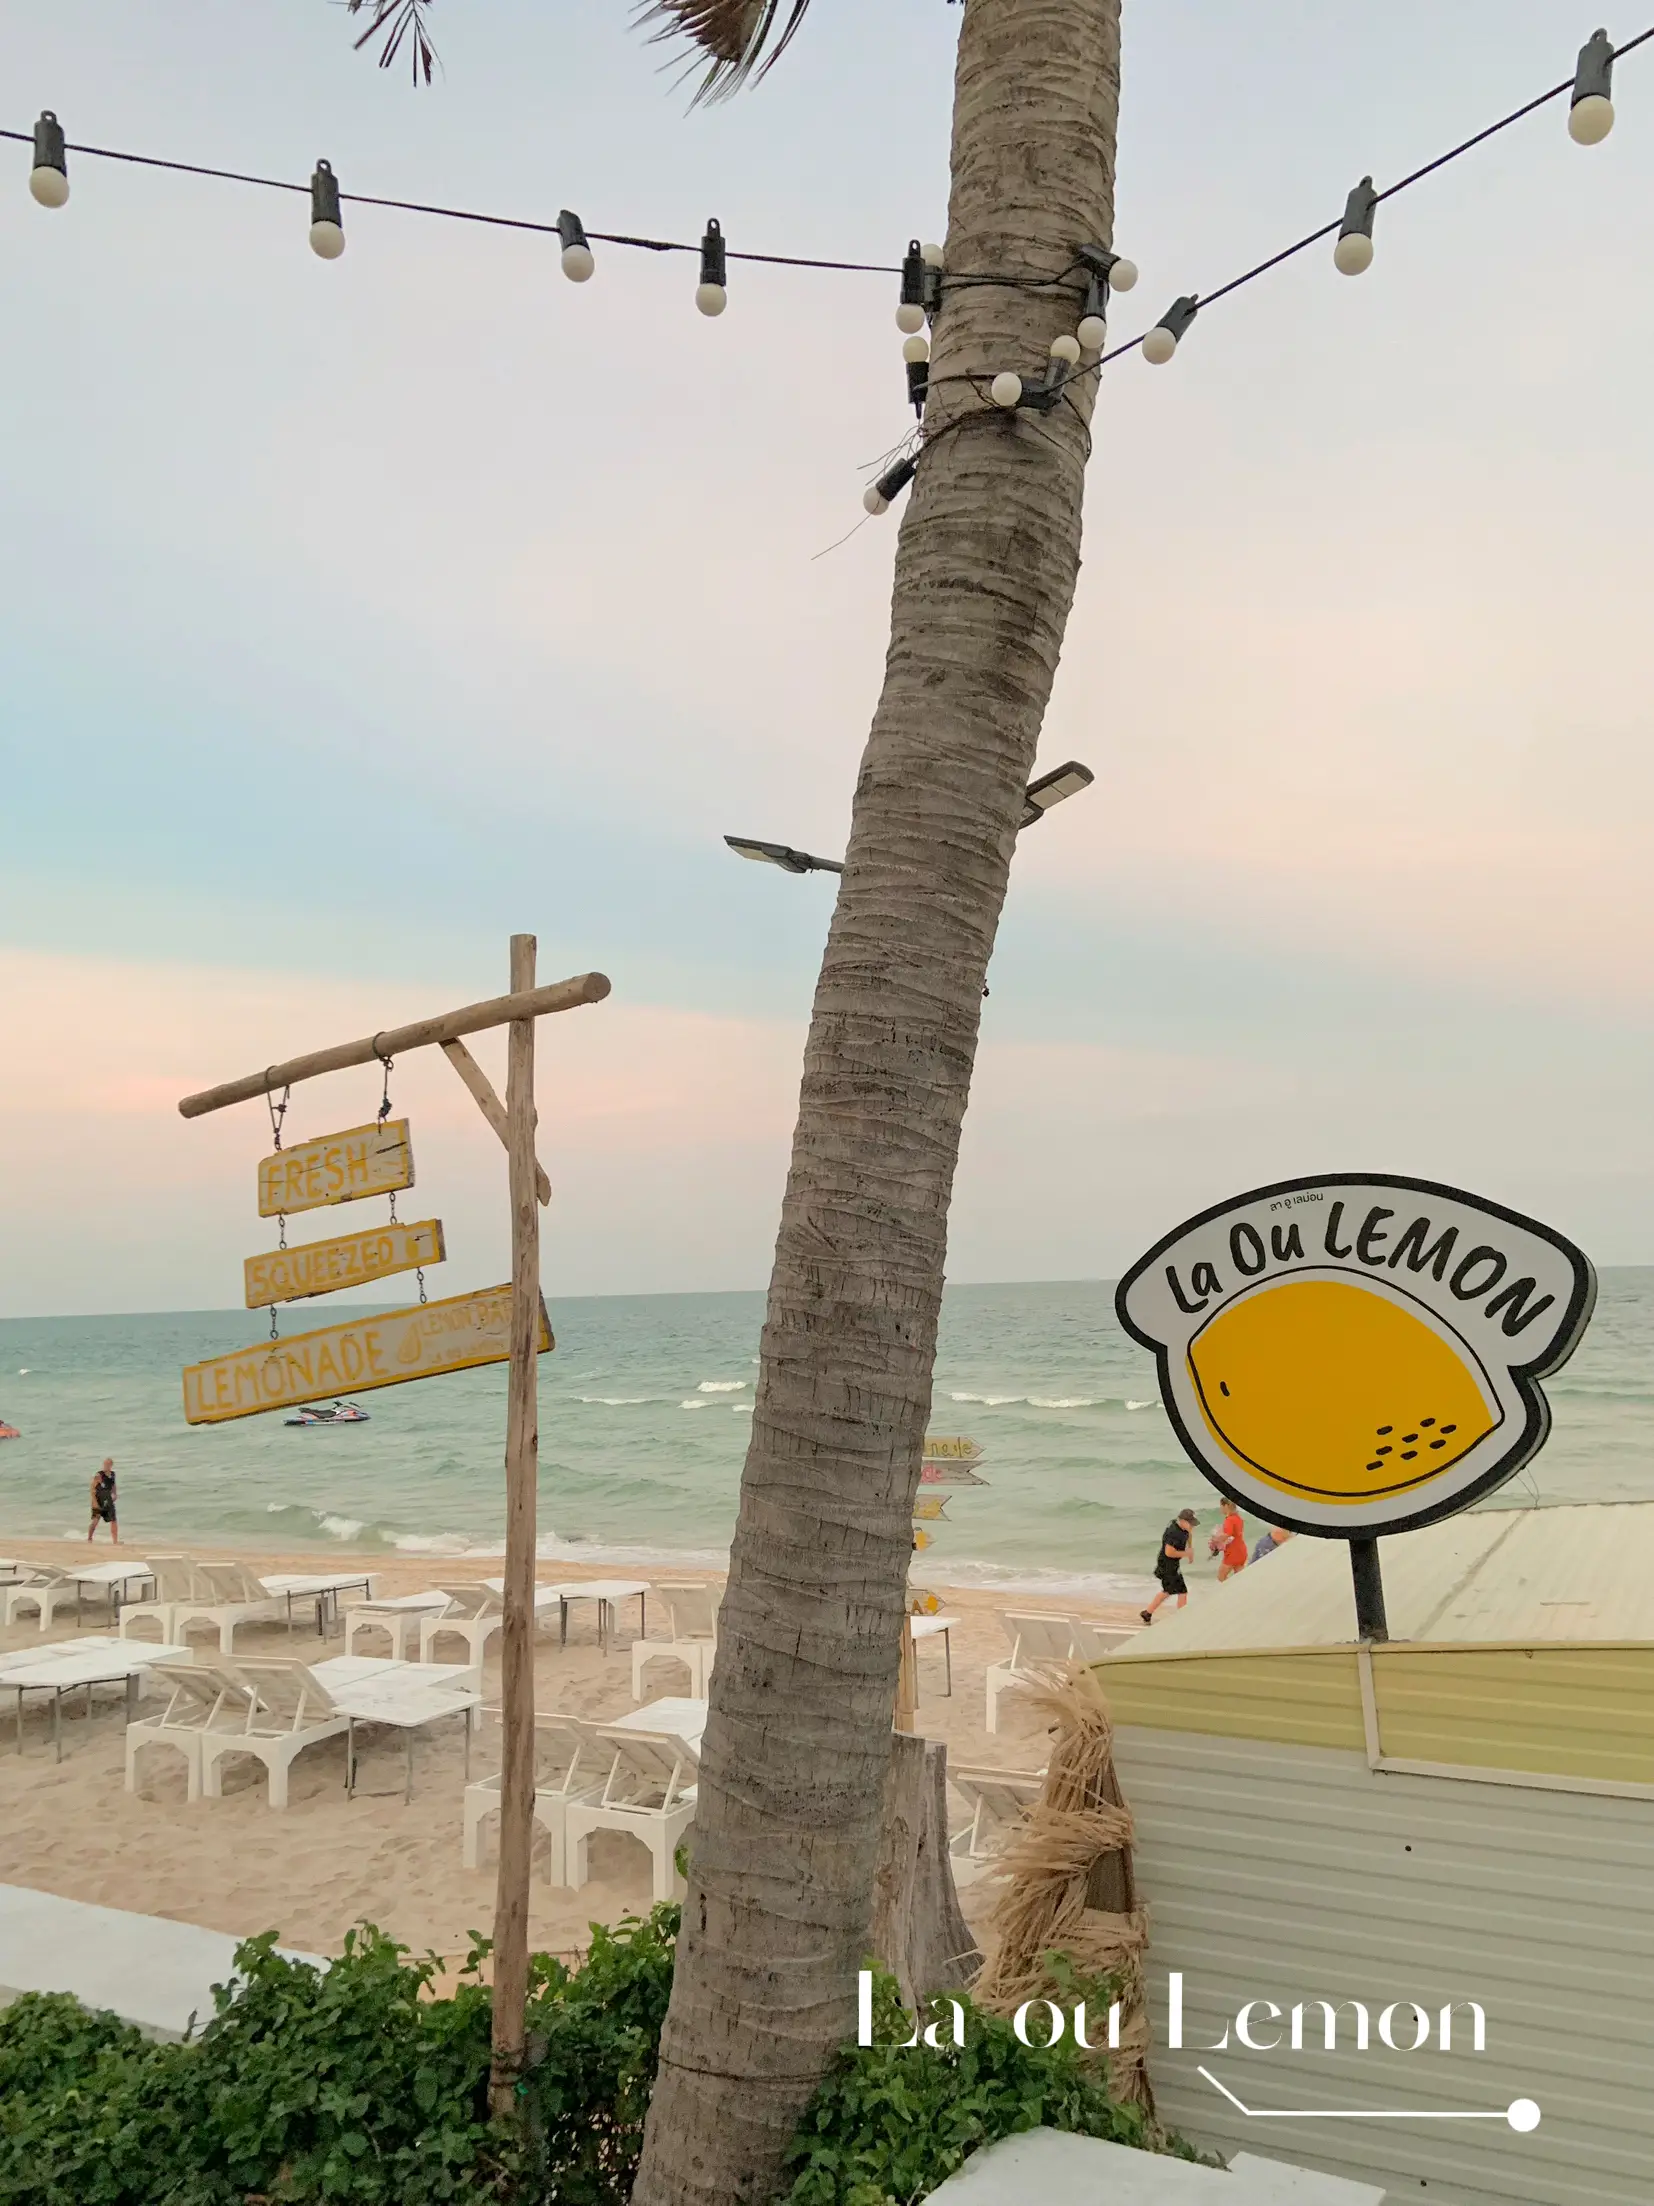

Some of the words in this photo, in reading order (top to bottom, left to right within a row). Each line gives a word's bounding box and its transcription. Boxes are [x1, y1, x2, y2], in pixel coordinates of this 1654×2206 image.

[267, 1143, 370, 1206] FRESH
[250, 1236, 394, 1299] SQUEEZED
[1165, 1262, 1224, 1314] La
[1229, 1222, 1305, 1276] Ou
[1324, 1201, 1556, 1337] LEMON
[198, 1331, 390, 1412] LEMONADE
